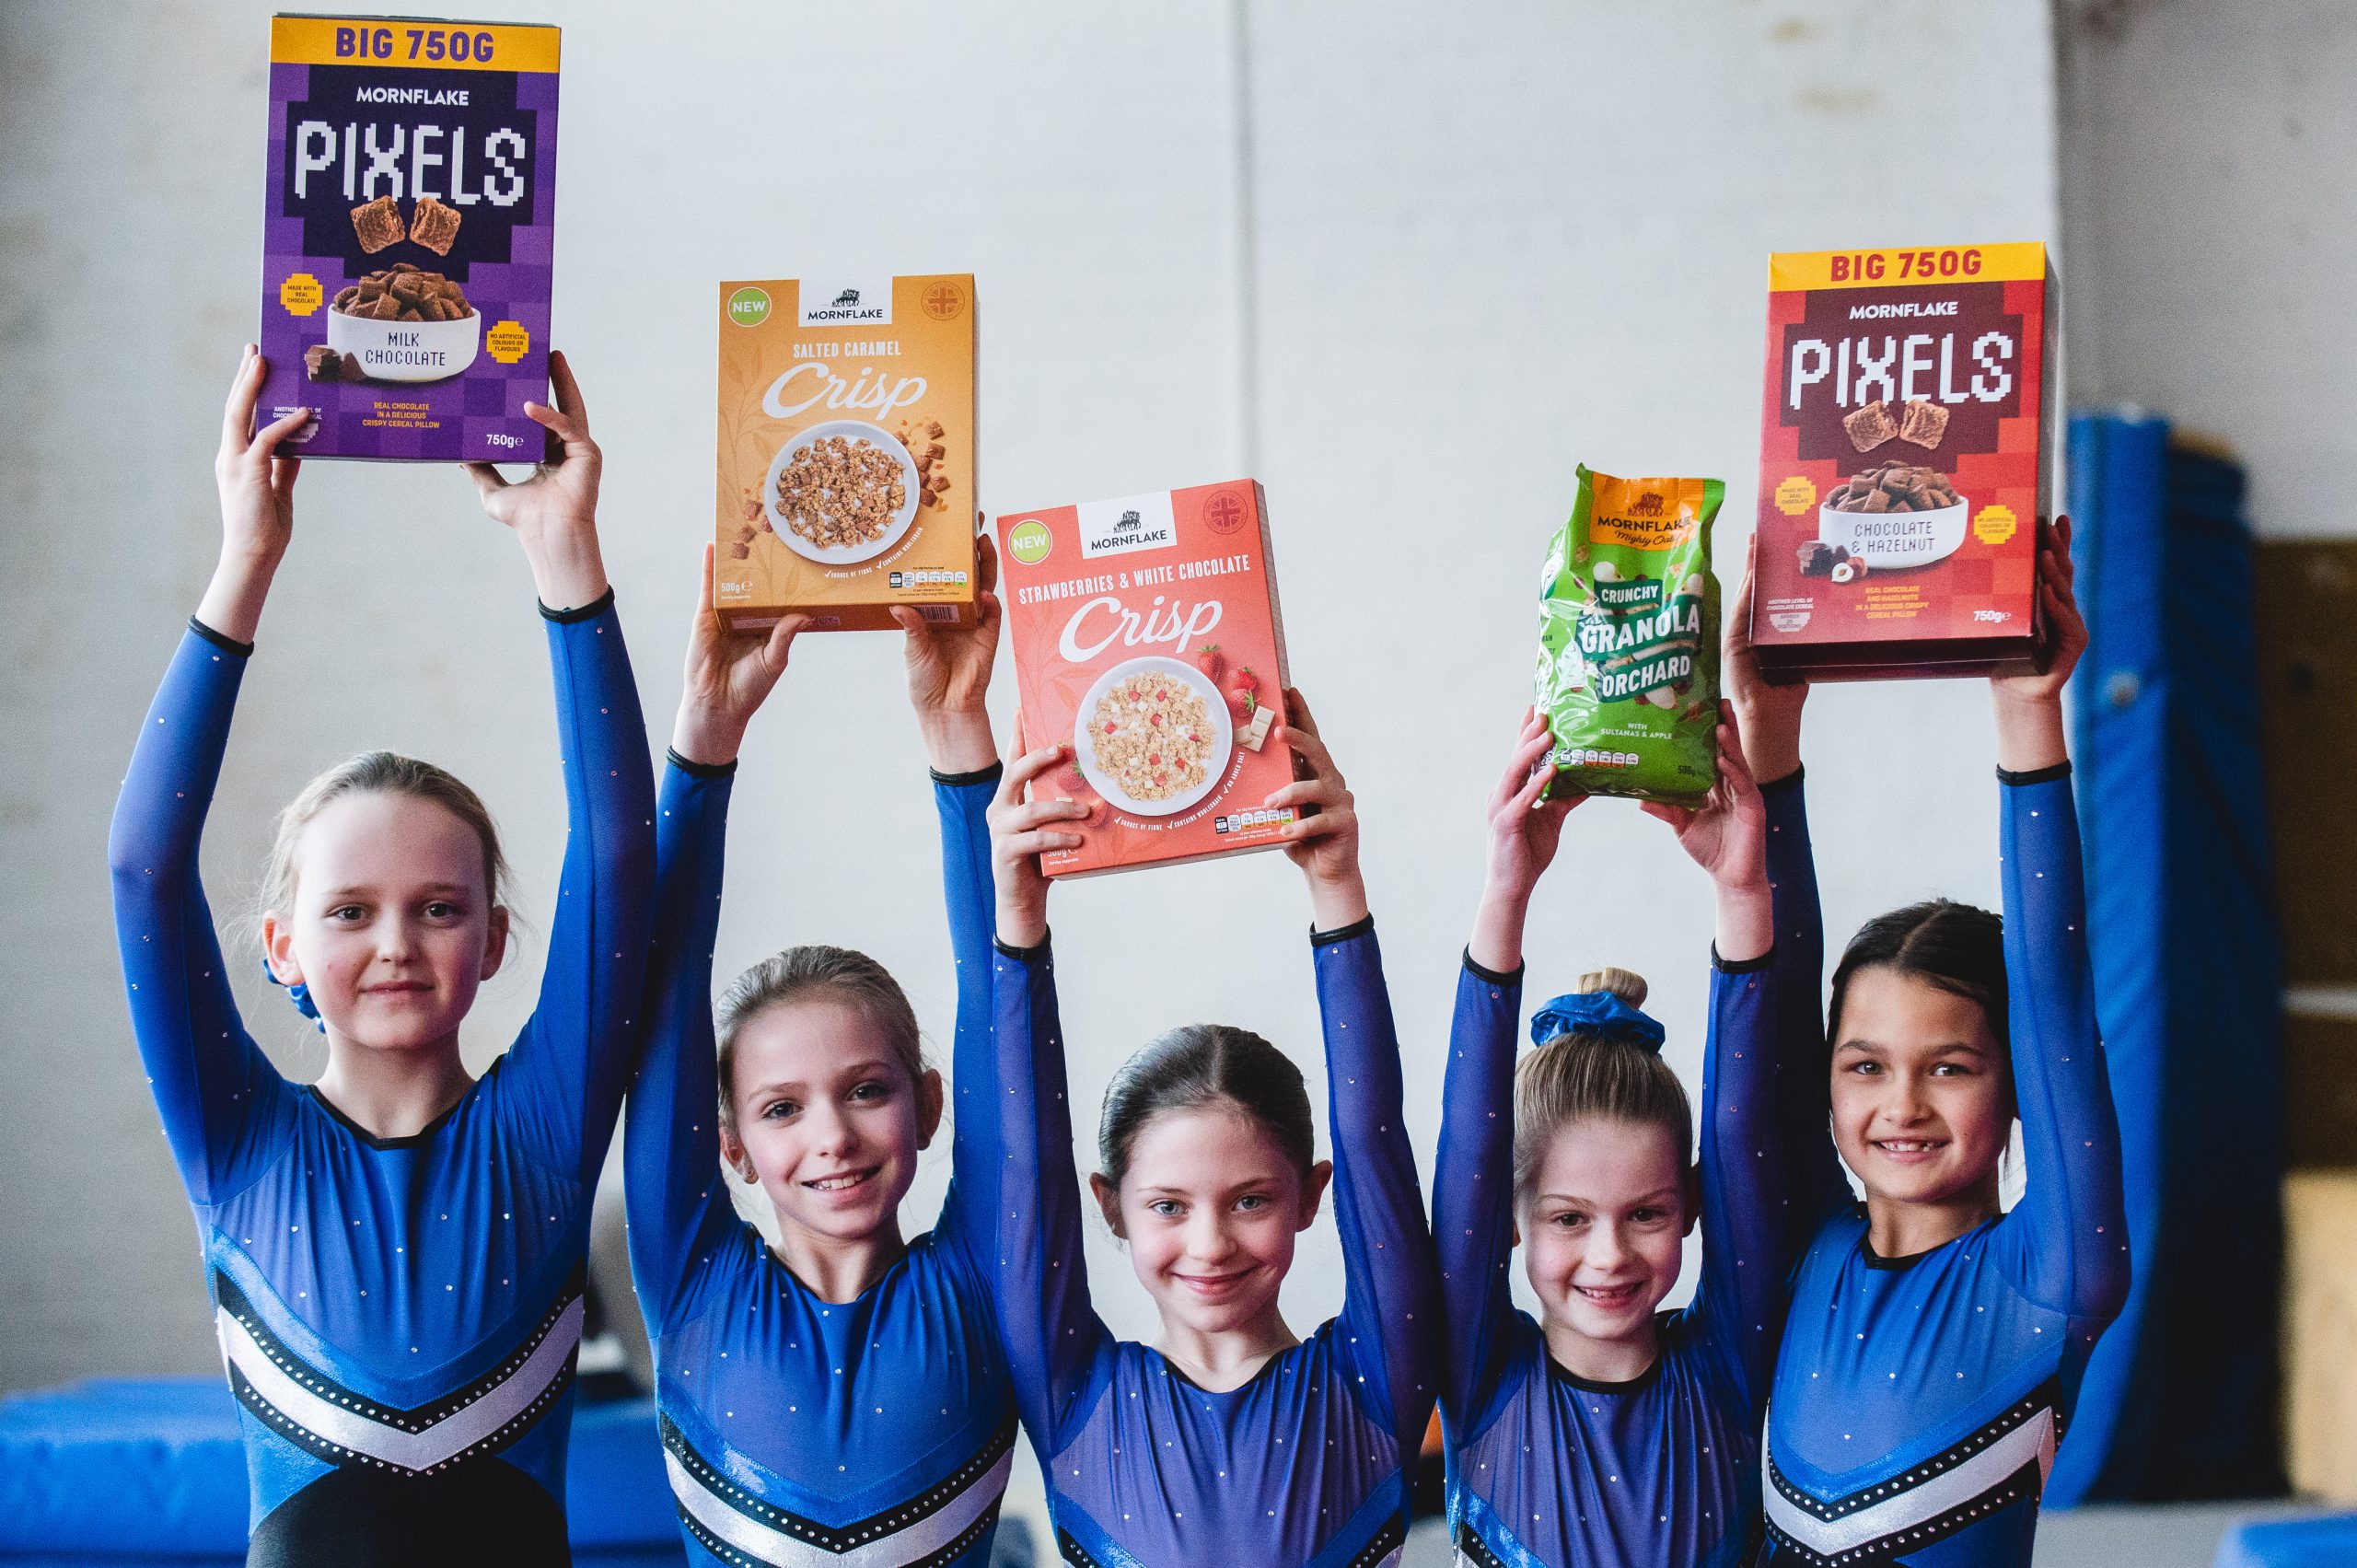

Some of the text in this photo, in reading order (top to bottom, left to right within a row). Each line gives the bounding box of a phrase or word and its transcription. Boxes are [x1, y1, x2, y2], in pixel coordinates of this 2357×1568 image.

[335, 27, 494, 63] BIG 750G
[355, 87, 470, 106] MORNFLAKE
[295, 121, 526, 206] PIXELS
[1830, 249, 1981, 282] BIG 750G
[732, 301, 766, 314] NEW
[807, 308, 883, 320] MORNFLAKE
[1849, 301, 1958, 319] MORNFLAKE
[388, 331, 420, 347] MILK
[366, 349, 446, 366] CHOCOLATE
[793, 341, 901, 358] SALTED CARAMEL
[1790, 331, 2013, 411] PIXELS
[761, 362, 928, 421] Crisp
[374, 401, 430, 411] REAL CHOCOLATE
[1614, 529, 1652, 548] Mighty
[1854, 522, 1933, 537] CHOCOLATE
[1013, 534, 1048, 552] NEW
[1090, 529, 1167, 551] MORNFLAKE
[1852, 539, 1935, 553] & HAZELNUT
[1018, 554, 1250, 605] STRAWBERRIES & WHITE CHOCOLATE
[1601, 585, 1659, 603] CRUNCHY
[1059, 596, 1223, 663] Crisp
[1581, 604, 1701, 654] GRANOLA
[1602, 655, 1690, 697] ORCHARD
[1600, 728, 1640, 738] SULTANAS
